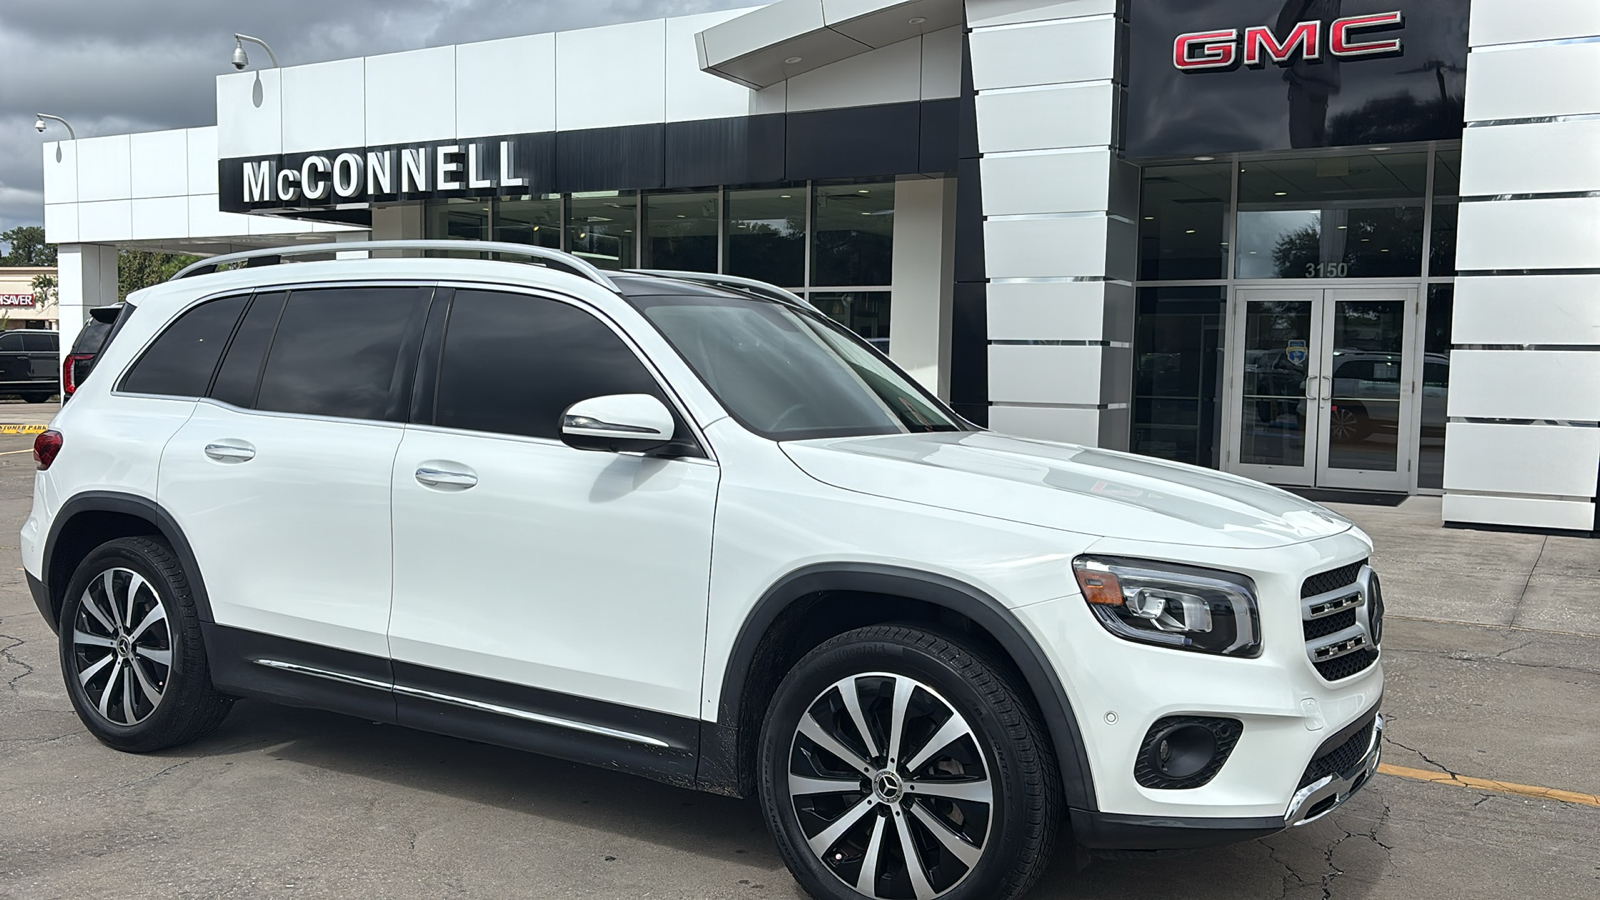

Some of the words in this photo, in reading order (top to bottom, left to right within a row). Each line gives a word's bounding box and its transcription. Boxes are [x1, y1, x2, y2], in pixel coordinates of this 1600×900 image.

[1173, 10, 1401, 70] GMC
[242, 140, 529, 202] McCONNELL
[1305, 262, 1348, 278] 3150
